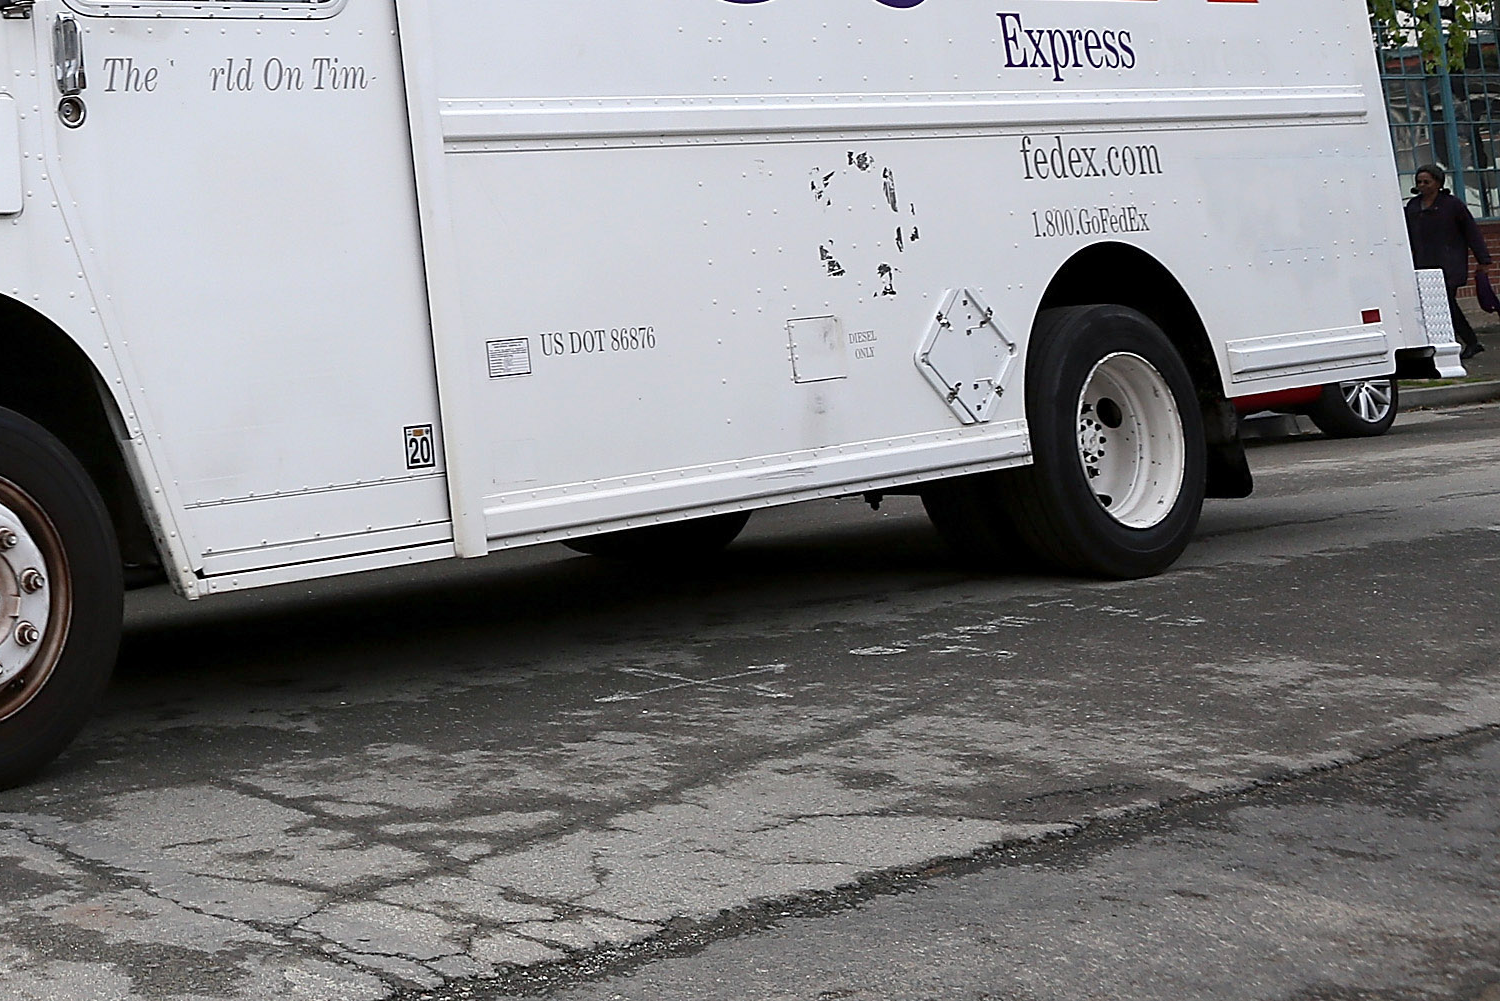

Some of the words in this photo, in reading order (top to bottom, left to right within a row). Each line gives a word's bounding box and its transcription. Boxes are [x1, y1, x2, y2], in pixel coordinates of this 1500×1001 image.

[995, 12, 1136, 82] Express
[103, 57, 158, 93] The
[263, 57, 305, 92] On
[311, 57, 377, 91] Tim
[1019, 135, 1164, 180] fedex.com
[1031, 206, 1150, 238] 1.800.GoFedEx
[540, 332, 565, 356] US
[568, 329, 606, 354] DOT
[610, 326, 656, 352] 86876
[848, 330, 878, 345] DIESEL
[854, 346, 875, 360] ONLY
[408, 436, 431, 464] 20
